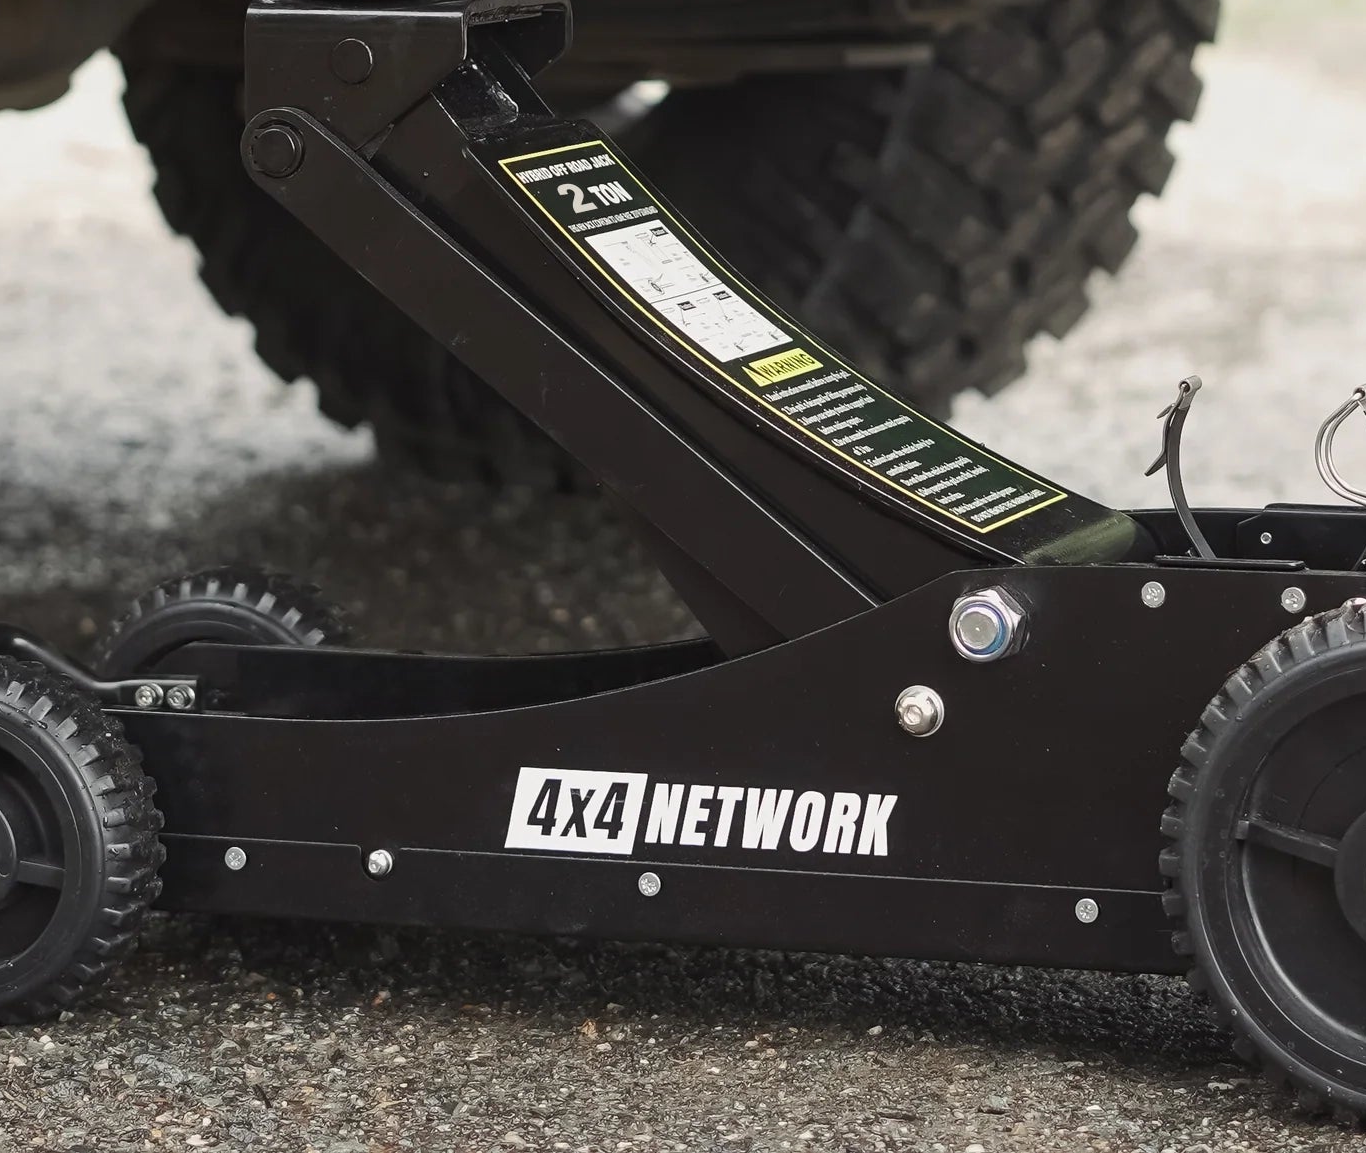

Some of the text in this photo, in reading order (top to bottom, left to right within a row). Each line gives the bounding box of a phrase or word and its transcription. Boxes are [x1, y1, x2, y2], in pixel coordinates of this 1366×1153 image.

[515, 153, 616, 185] HYBRID OFF ROAD JACK
[557, 181, 634, 214] 2 TON
[756, 353, 816, 378] WARNING
[527, 778, 899, 857] 4x4 NETWORK
